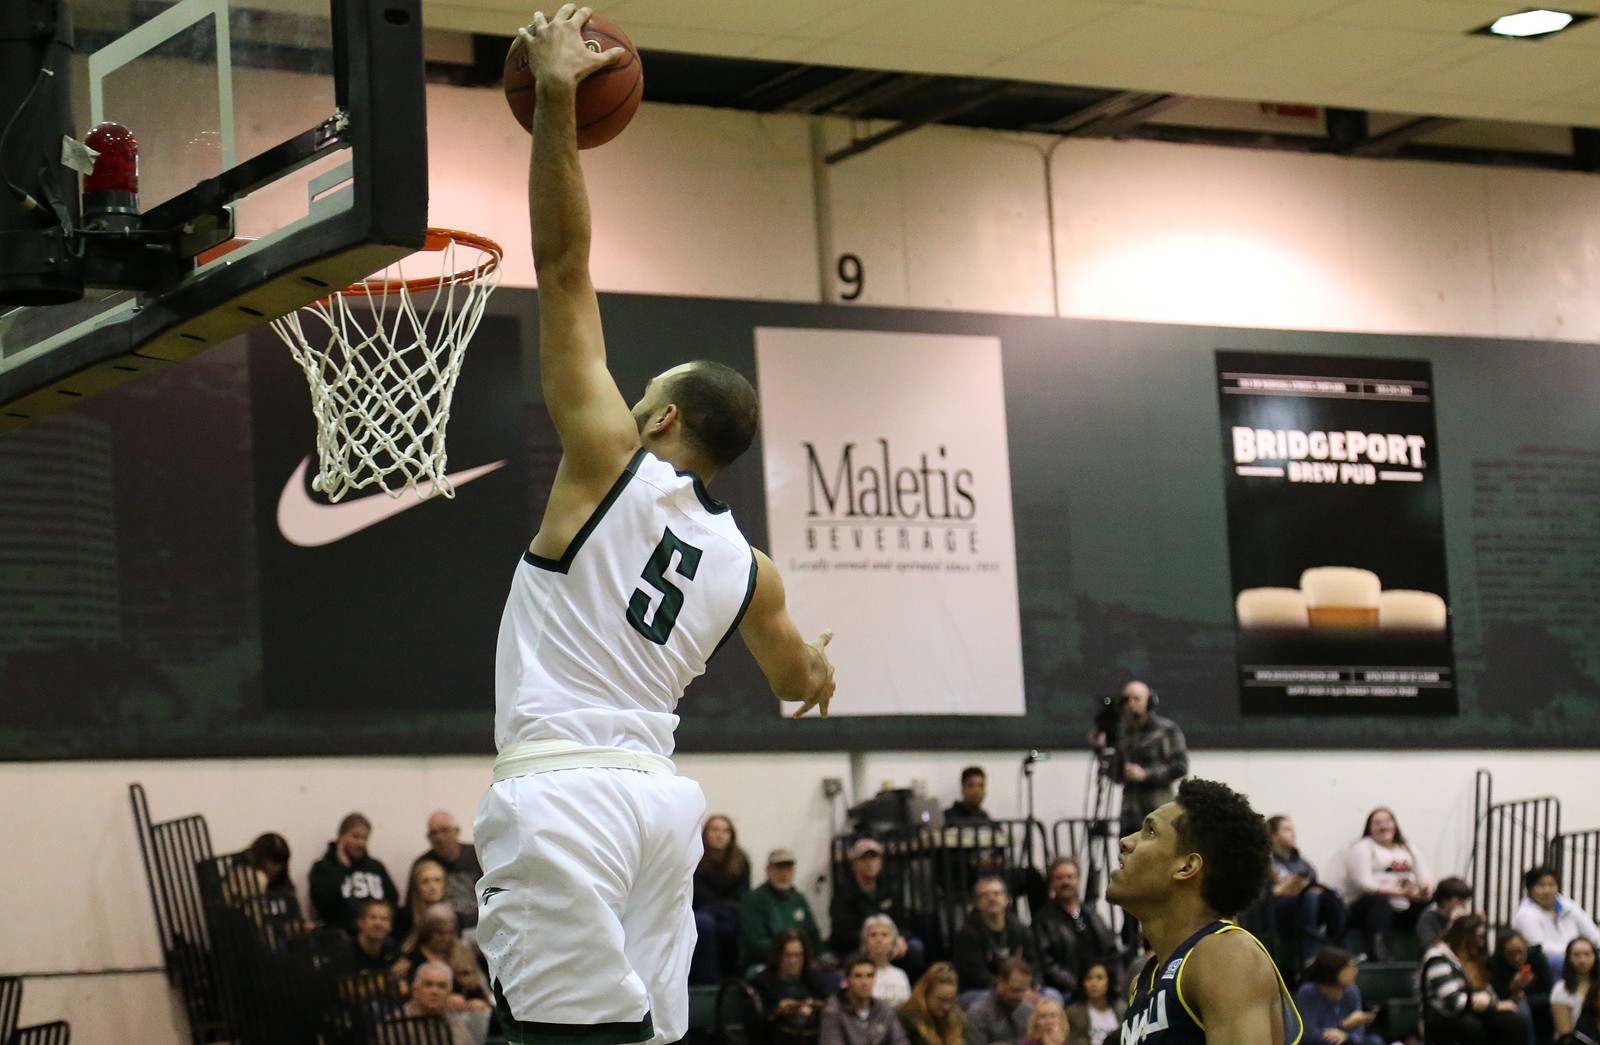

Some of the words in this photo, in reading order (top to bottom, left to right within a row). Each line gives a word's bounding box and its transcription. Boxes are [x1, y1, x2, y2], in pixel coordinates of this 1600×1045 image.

[837, 253, 864, 300] 9
[1232, 426, 1426, 468] BRIDGEPORT
[802, 437, 977, 521] Maletis
[1287, 461, 1339, 484] BREW
[1340, 463, 1377, 486] PUB
[806, 526, 979, 554] BEVERAGE
[625, 525, 704, 646] 5
